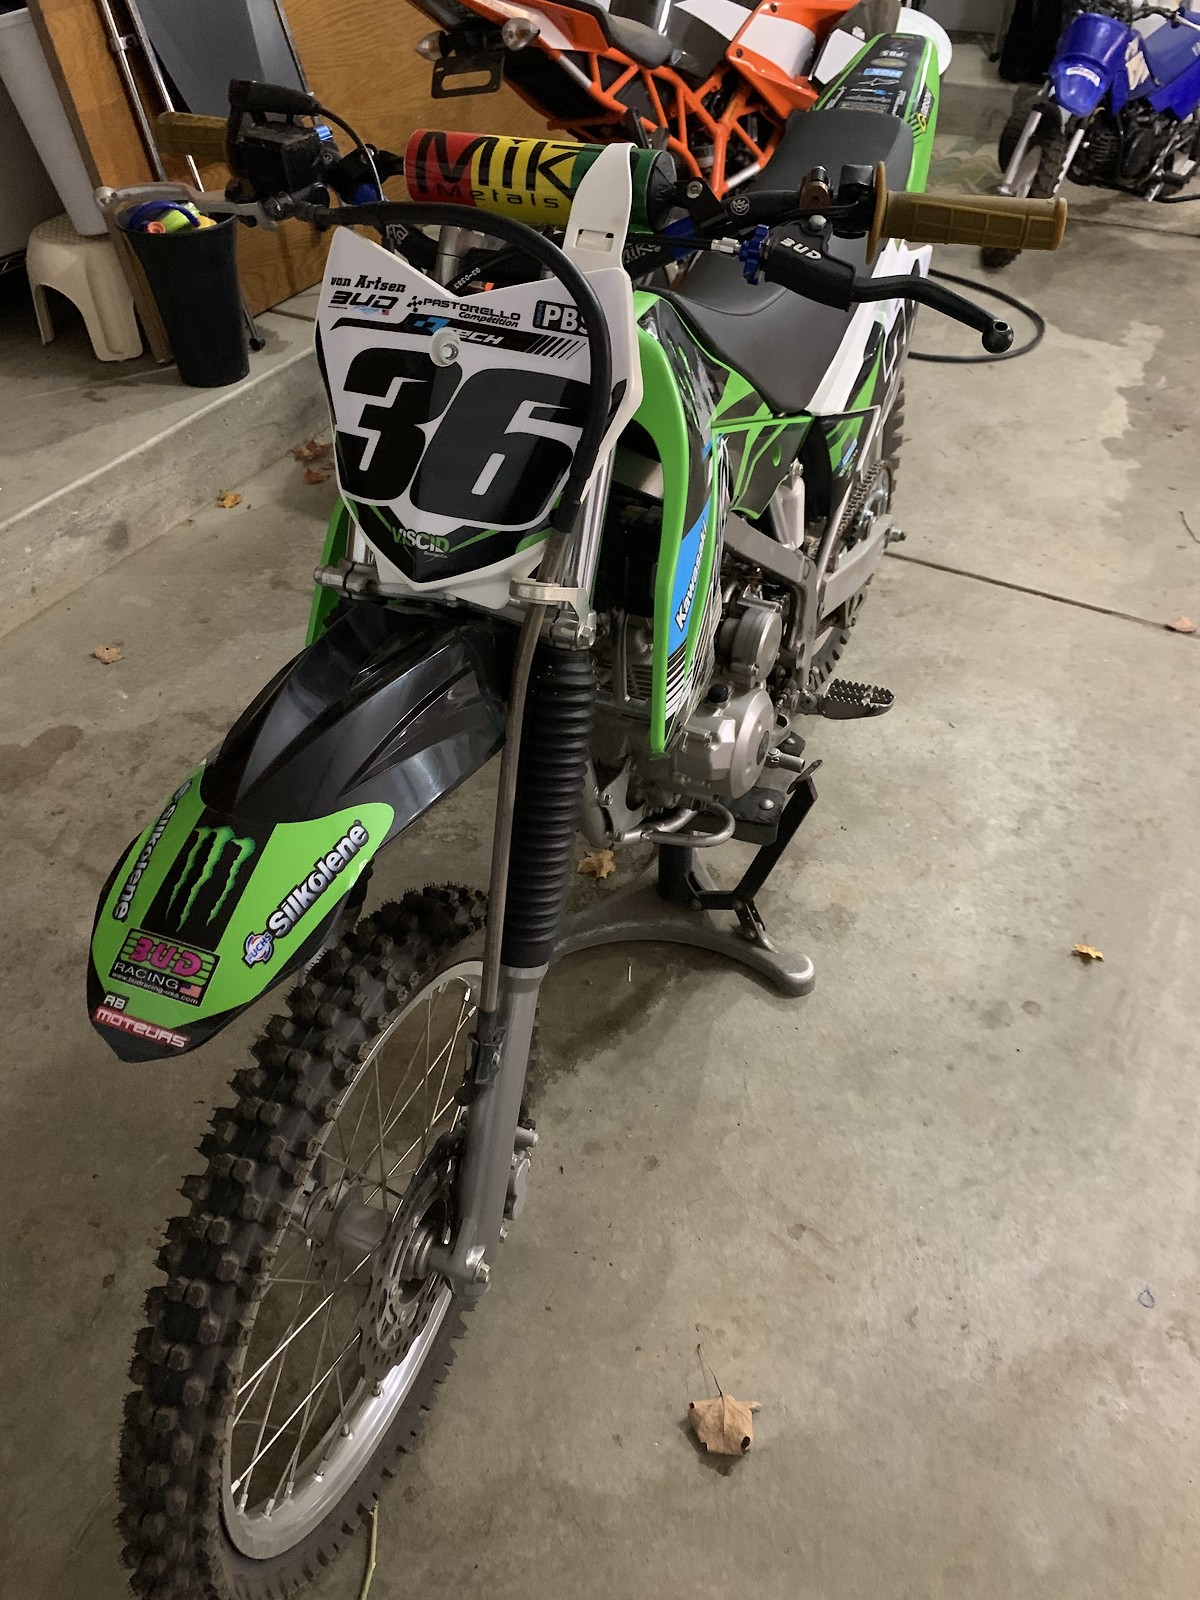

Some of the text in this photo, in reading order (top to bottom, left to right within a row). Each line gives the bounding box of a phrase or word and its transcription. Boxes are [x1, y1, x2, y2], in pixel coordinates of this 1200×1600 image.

[331, 274, 407, 293] von Artsen
[423, 298, 521, 321] PASTORELLO
[336, 347, 590, 526] 36
[112, 802, 178, 922] Silkolene
[266, 822, 370, 938] Silkolene
[246, 932, 273, 963] FUCHS
[114, 961, 179, 992] RACING
